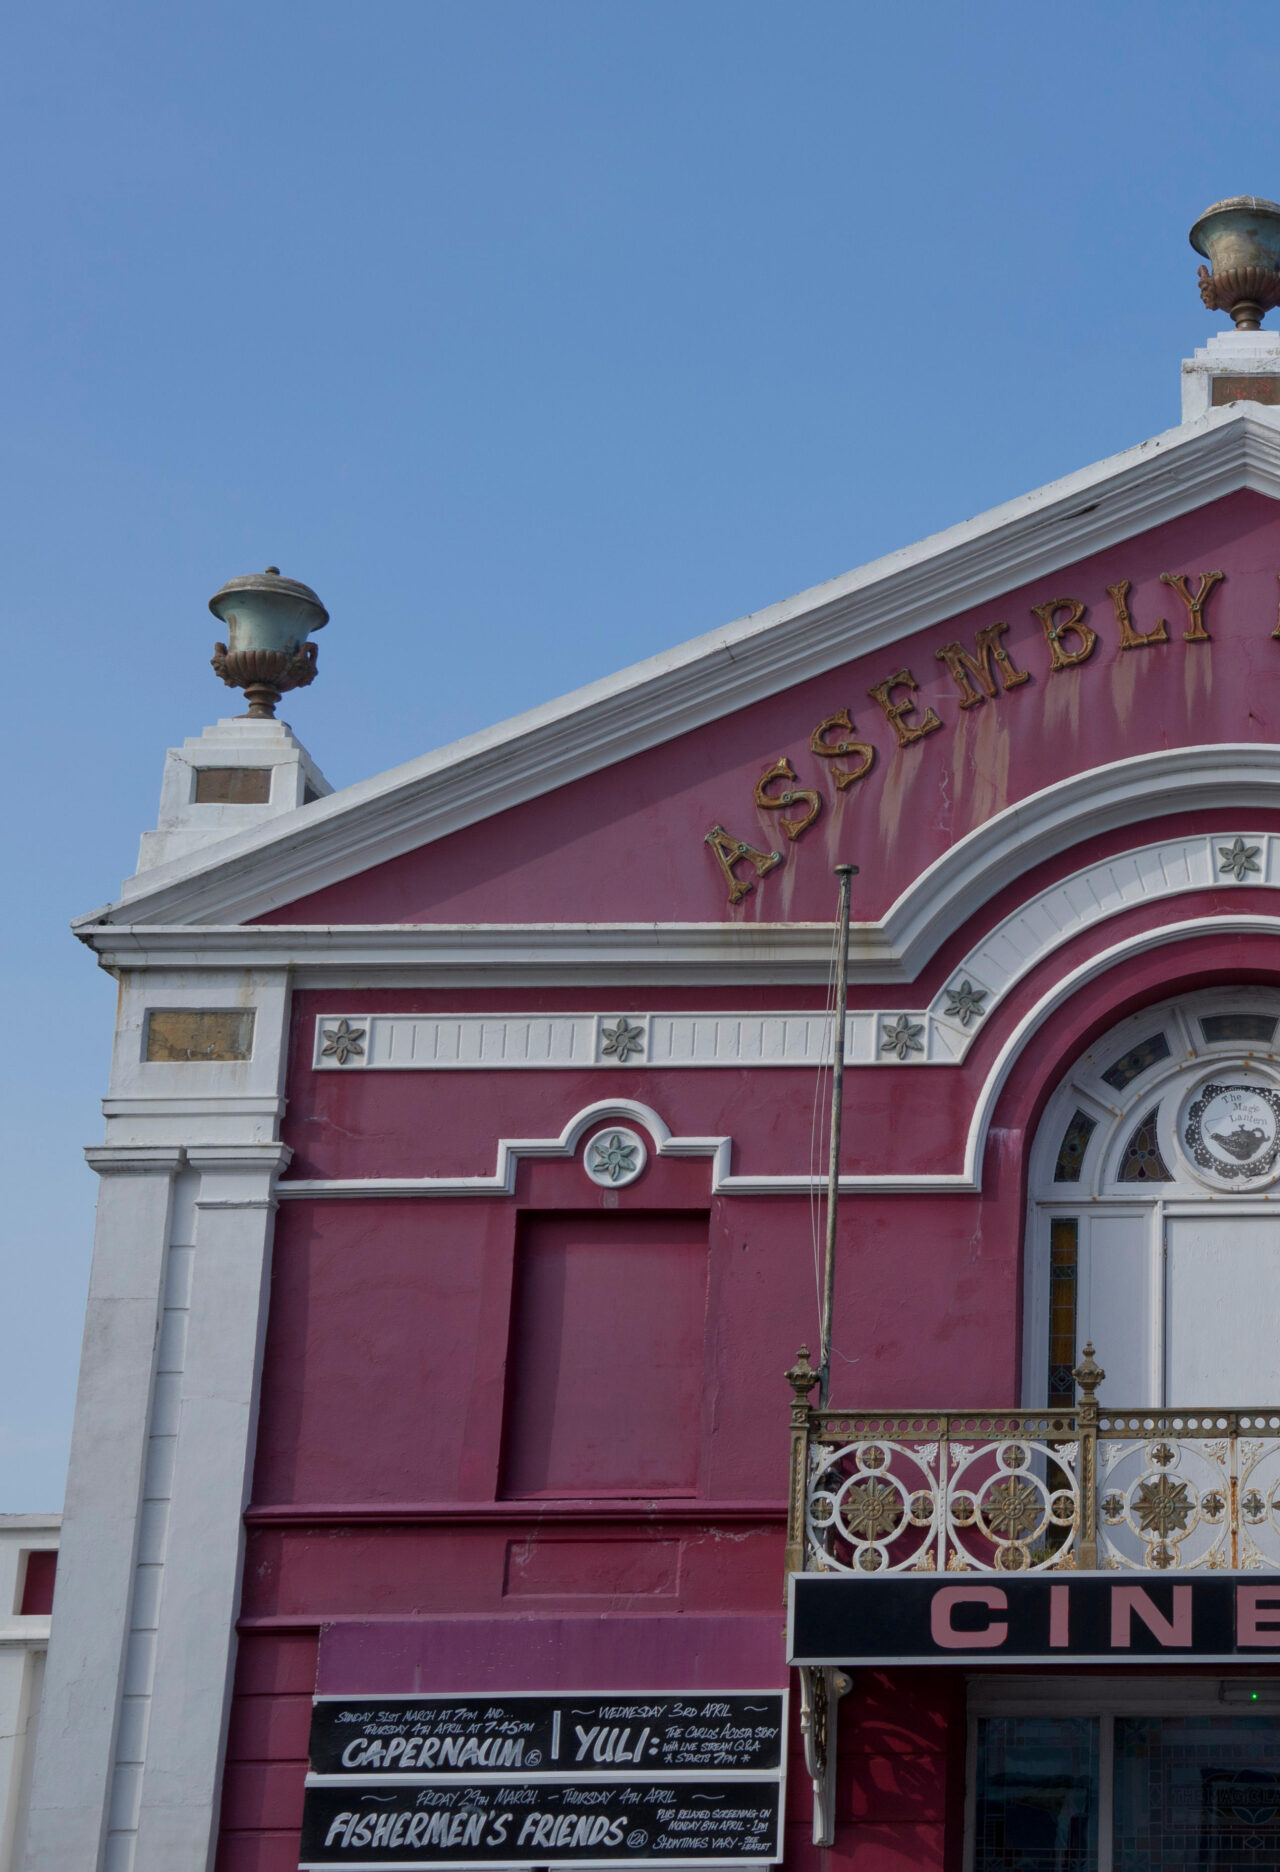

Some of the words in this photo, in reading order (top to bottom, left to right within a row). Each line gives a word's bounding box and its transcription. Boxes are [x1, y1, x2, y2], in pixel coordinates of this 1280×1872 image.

[704, 570, 1225, 904] ASSEMBLY
[1222, 1093, 1242, 1104] The
[1229, 1114, 1268, 1125] Lantern
[335, 1711, 374, 1723] SUNDAY
[402, 1710, 437, 1721] MARCH
[438, 1710, 453, 1721] AT
[454, 1708, 478, 1721] 7PM
[598, 1705, 667, 1719] WEDNESDAY
[668, 1703, 698, 1717] 3RD
[700, 1703, 732, 1717] APRIL
[363, 1724, 410, 1735] THURSDAY
[411, 1723, 431, 1735] 4TH
[433, 1722, 464, 1735] APRIL
[466, 1722, 483, 1734] AT
[665, 1726, 684, 1738] THE
[685, 1726, 719, 1739] CARLOS
[719, 1723, 753, 1738] ACOSTA
[754, 1727, 779, 1738] STORY
[575, 1725, 660, 1763] YULI:
[680, 1742, 698, 1751] LIVE
[700, 1742, 733, 1752] STREAM
[733, 1740, 761, 1752] Q&A
[341, 1737, 525, 1768] CAPERNAUM
[675, 1753, 711, 1763] STARTS
[714, 1752, 737, 1764] 7PM
[416, 1789, 460, 1807] FRIDAY
[458, 1788, 489, 1807] 29TH
[562, 1788, 616, 1806] THURSDAY
[619, 1787, 642, 1804] 4TH
[643, 1787, 677, 1804] APRIL
[656, 1809, 676, 1820] PLUS
[677, 1808, 711, 1820] RELAXED
[712, 1808, 759, 1819] SCREENING
[759, 1809, 773, 1818] ON
[324, 1809, 513, 1848] FISHERMEN'S
[517, 1812, 628, 1848] FRIENDS
[668, 1820, 701, 1832] MONDAY
[719, 1820, 745, 1831] APRIL
[652, 1834, 708, 1850] SHOWTIMES
[711, 1836, 739, 1849] VARY
[741, 1842, 772, 1851] LEAFLET
